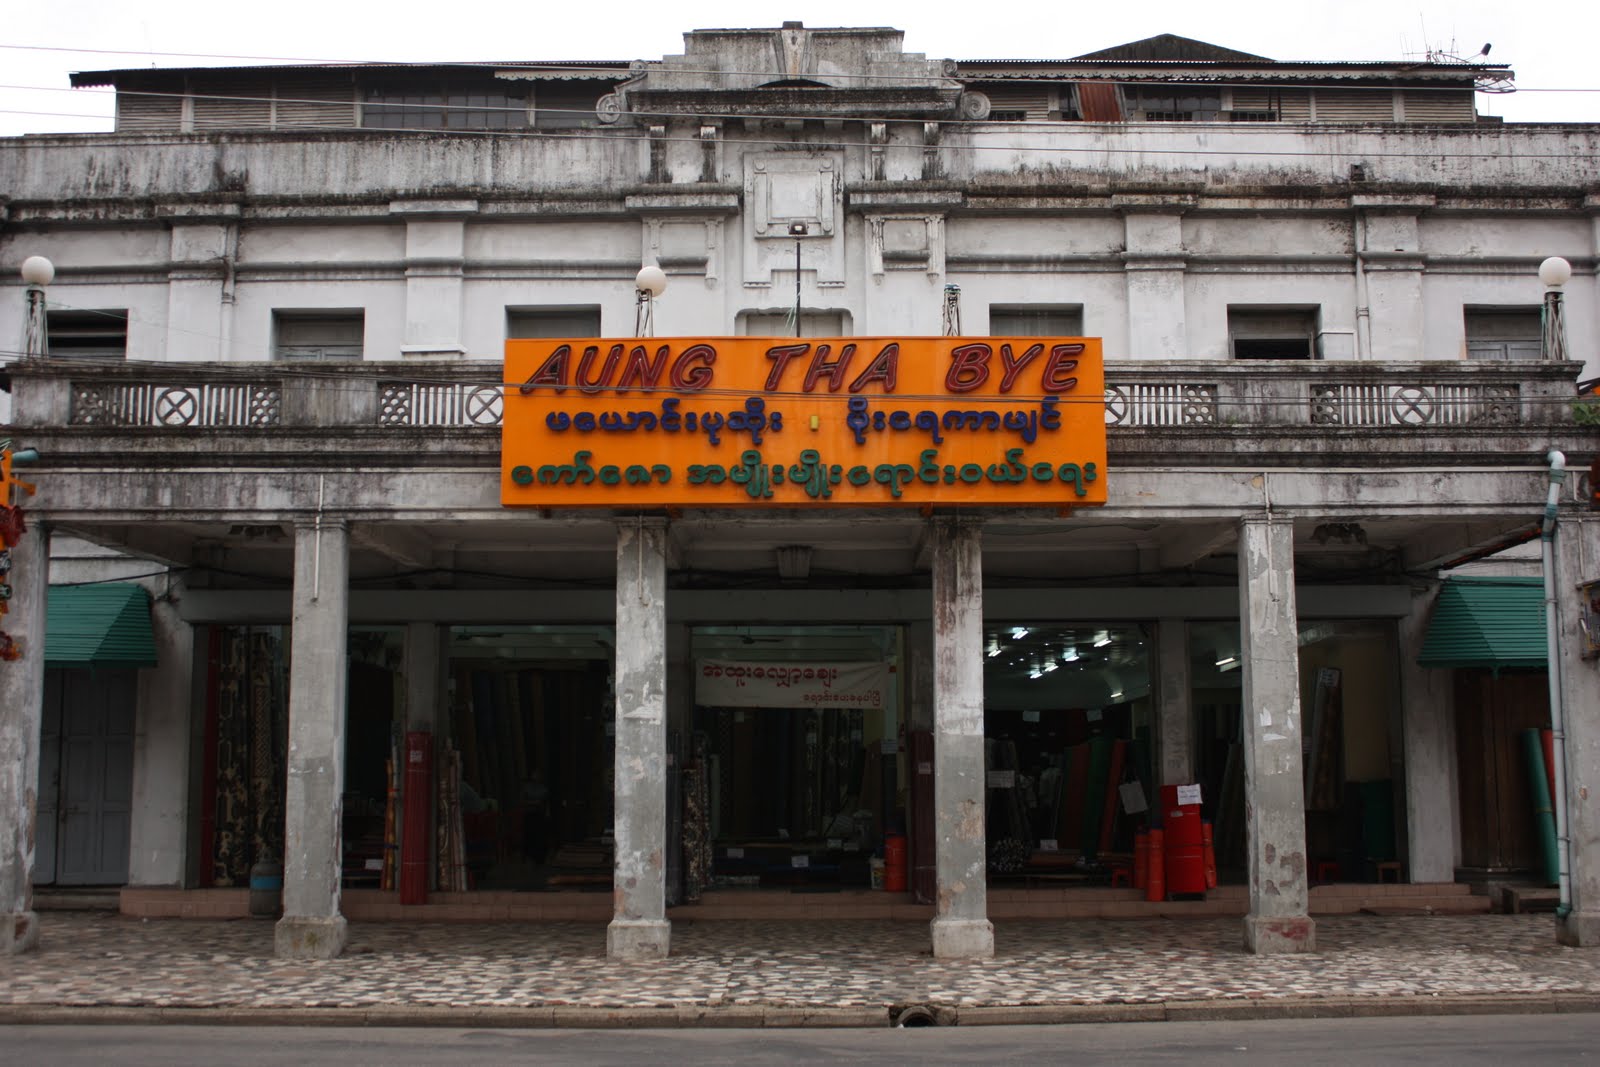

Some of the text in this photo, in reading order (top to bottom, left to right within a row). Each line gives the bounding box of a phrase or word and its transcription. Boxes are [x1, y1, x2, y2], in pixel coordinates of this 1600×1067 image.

[519, 342, 1086, 395] AUNG THA BYE
